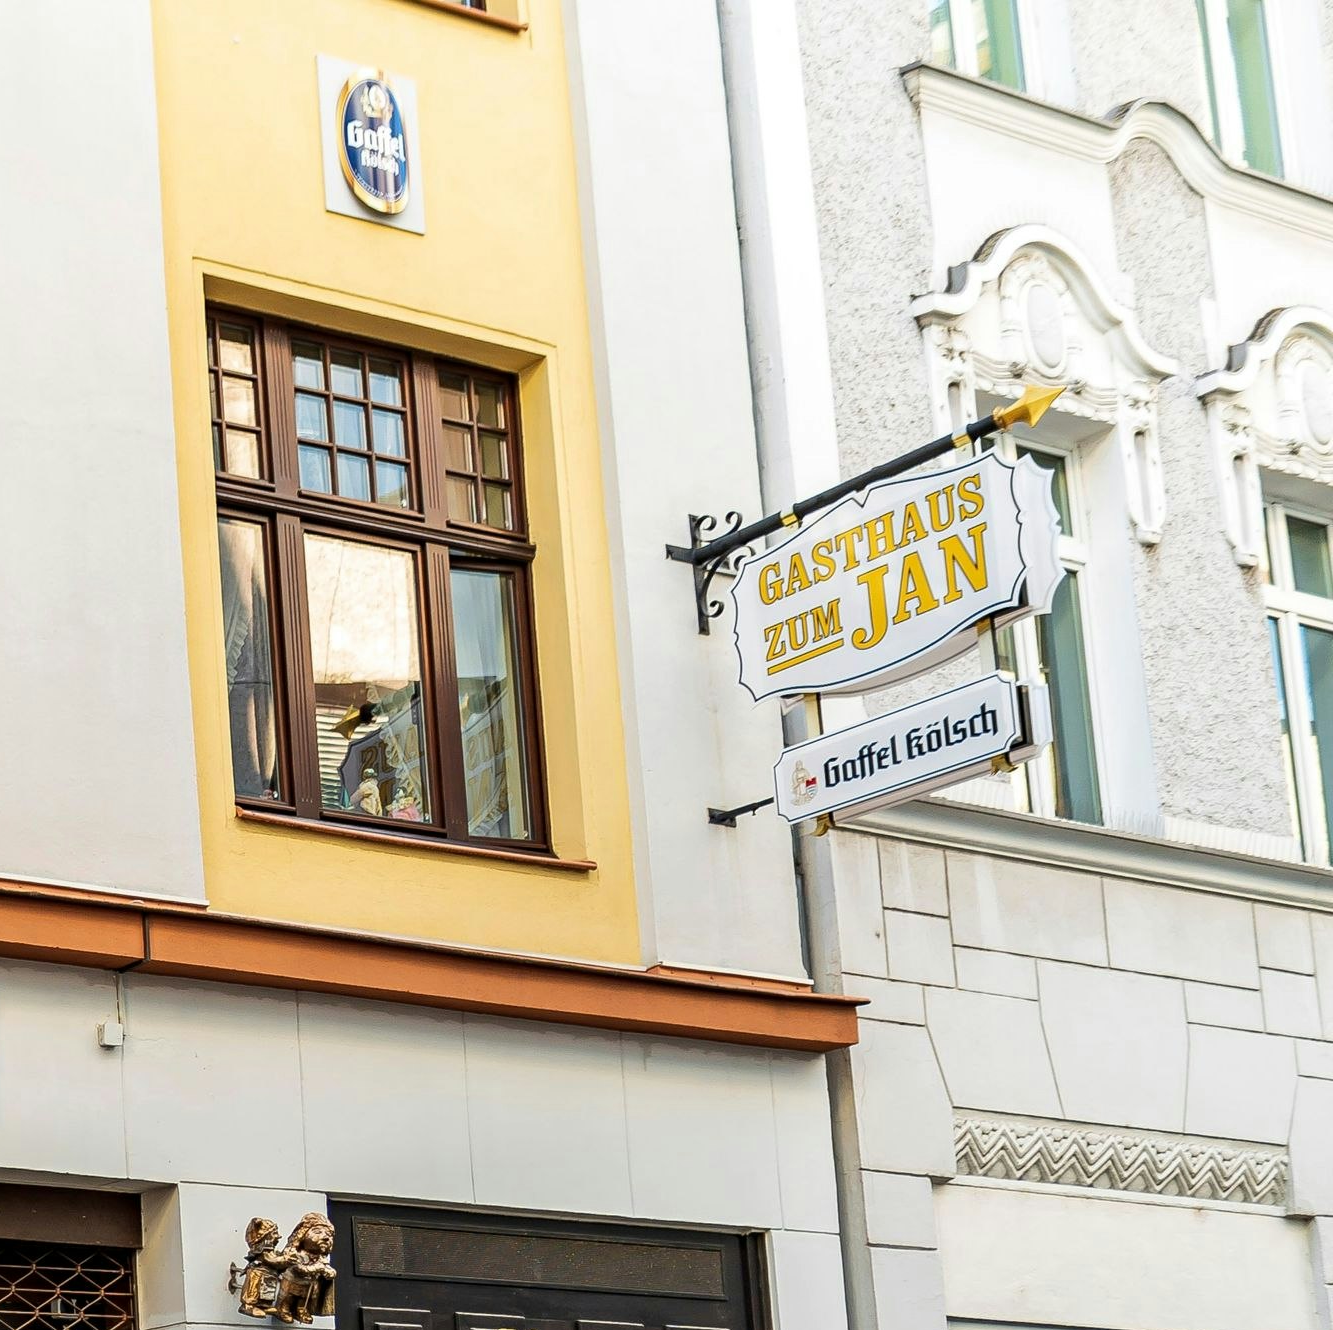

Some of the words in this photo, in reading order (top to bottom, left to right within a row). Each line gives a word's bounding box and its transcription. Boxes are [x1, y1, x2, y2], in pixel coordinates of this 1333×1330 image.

[346, 120, 406, 162] Gaffel
[758, 474, 985, 606] GASTHAUS
[763, 598, 844, 663] ZUM
[851, 523, 989, 650] JAN
[822, 733, 902, 789] Gaffel
[906, 702, 1000, 762] Kölsch
